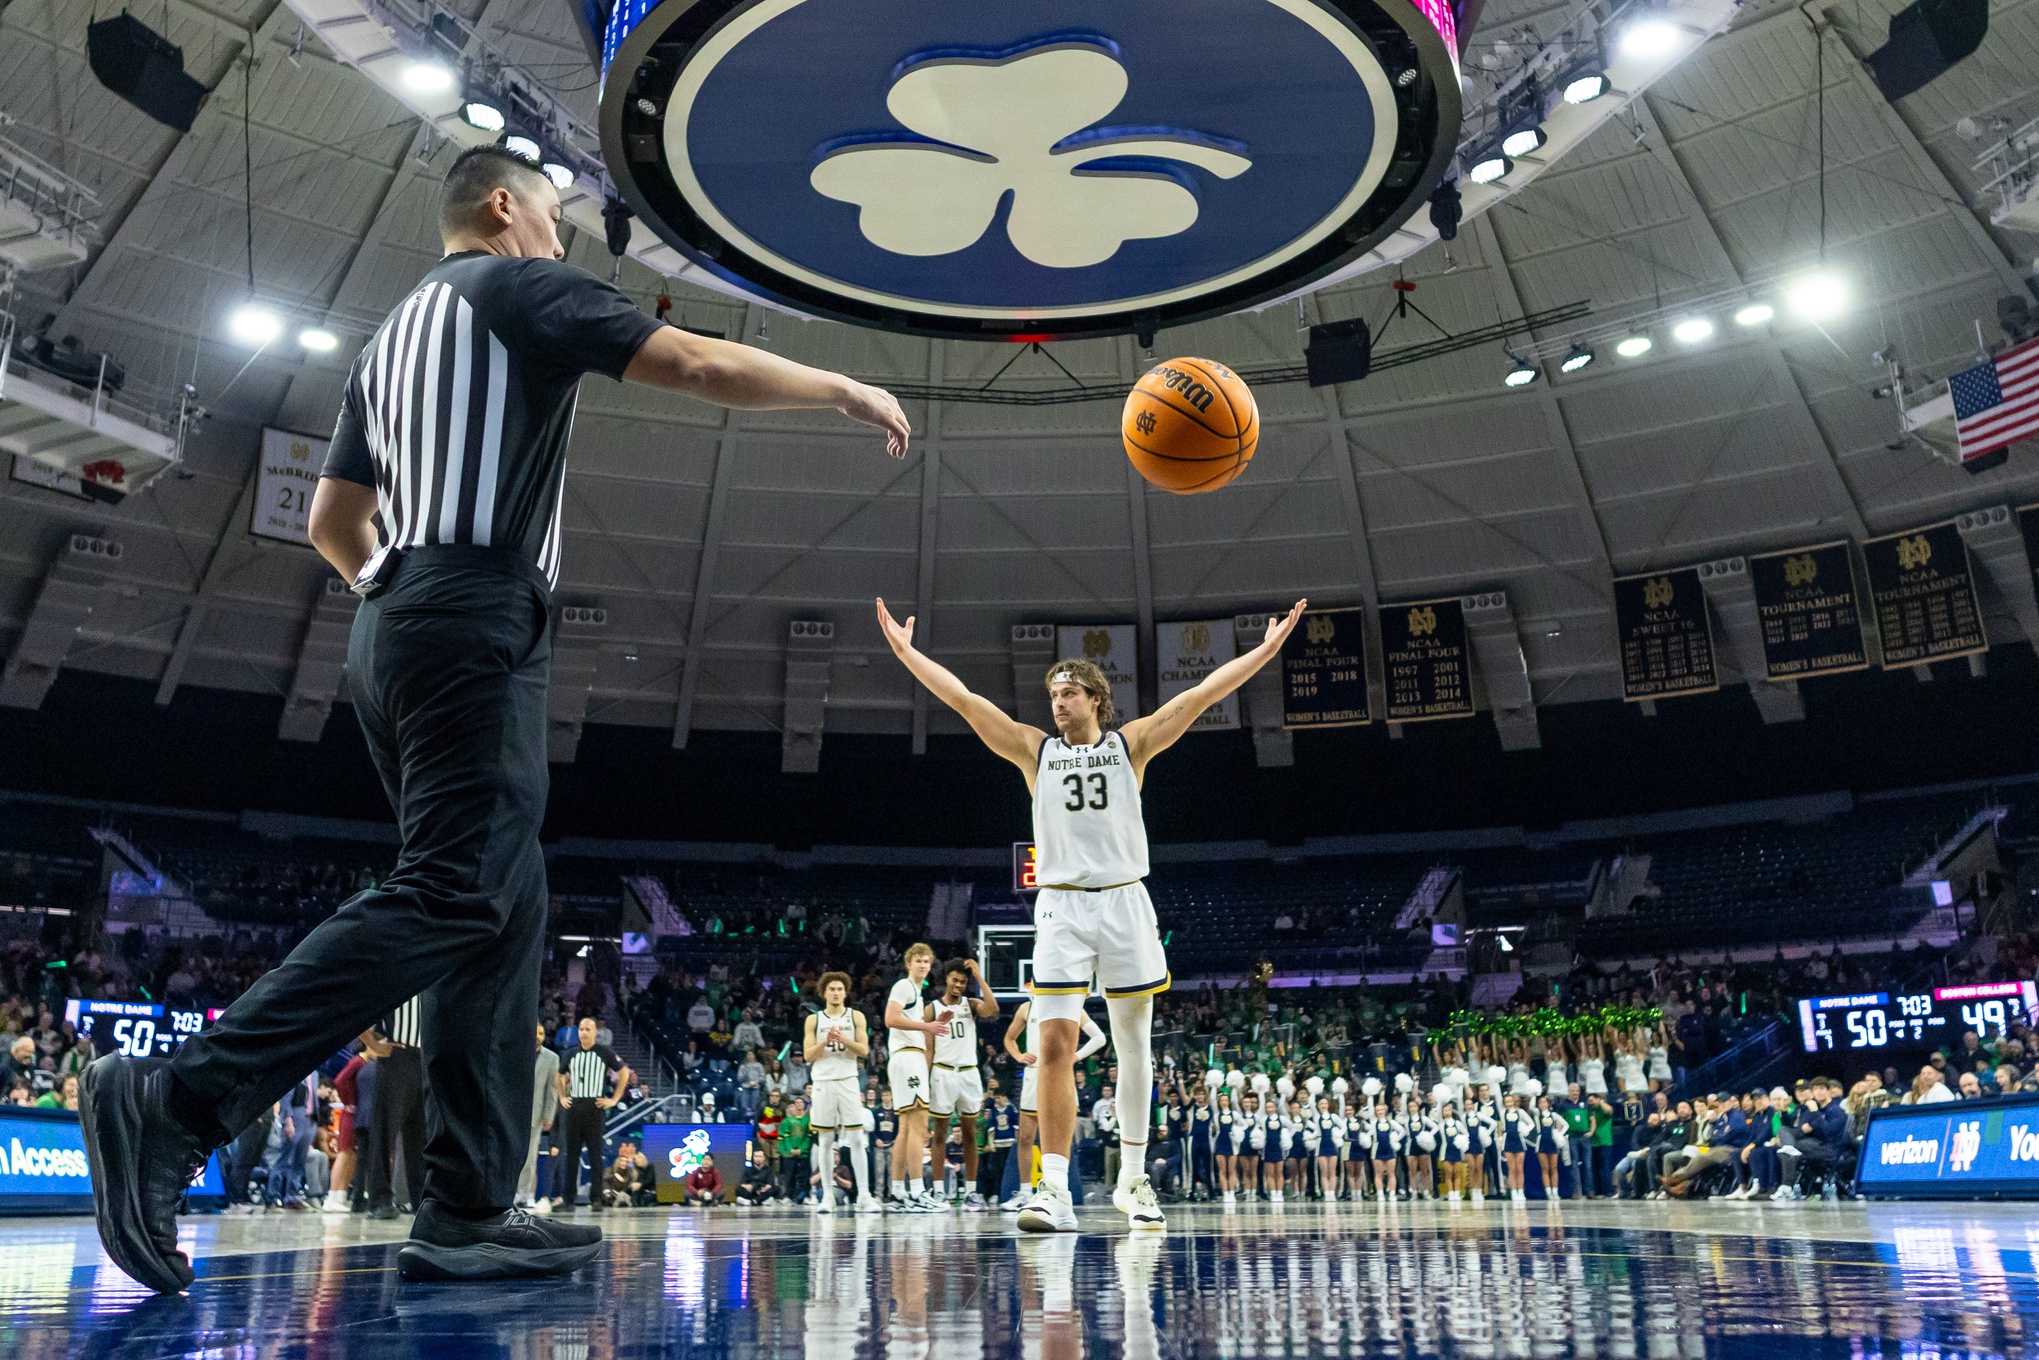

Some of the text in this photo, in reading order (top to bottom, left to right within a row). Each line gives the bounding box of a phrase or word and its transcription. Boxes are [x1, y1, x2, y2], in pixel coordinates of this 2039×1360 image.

[267, 466, 318, 482] McBRID
[280, 488, 304, 513] 21
[1761, 594, 1851, 616] TOURNAMENT
[1632, 622, 1675, 637] SWEET
[1407, 638, 1440, 648] NCAA
[1305, 647, 1339, 657] NCAA
[1389, 648, 1460, 662] FINAL FOUR
[1178, 656, 1216, 668] NCAA
[1287, 656, 1359, 668] FINAL FOUR
[1393, 662, 1458, 677] 1997 2001
[1162, 669, 1210, 680] CHAMP
[1292, 671, 1357, 684] 2015 2018
[1665, 673, 1713, 689] BASKETBALL
[1396, 675, 1460, 690] 2011 2012
[1292, 686, 1318, 696] 2019
[1396, 688, 1460, 703] 2013 2014
[1390, 700, 1470, 715] WOMEN'S BASKETBALL
[1286, 710, 1367, 721] WOMEN'S BASKETBALL
[1048, 755, 1120, 770] NOTRE DAME
[1063, 772, 1108, 812] 33
[1940, 984, 2018, 998] BOSTON COLLEGE
[90, 1002, 152, 1016] NOTRE DAME
[1820, 996, 1878, 1008] NOTRE DAME
[1896, 995, 1932, 1016] 7:03
[171, 1011, 204, 1032] 7:03
[1962, 1000, 2008, 1038] 49
[950, 1021, 964, 1039] 10
[1847, 1010, 1888, 1048] 50
[114, 1018, 155, 1058] 50
[1881, 1134, 1938, 1165] verizon
[11, 1138, 88, 1177] Access
